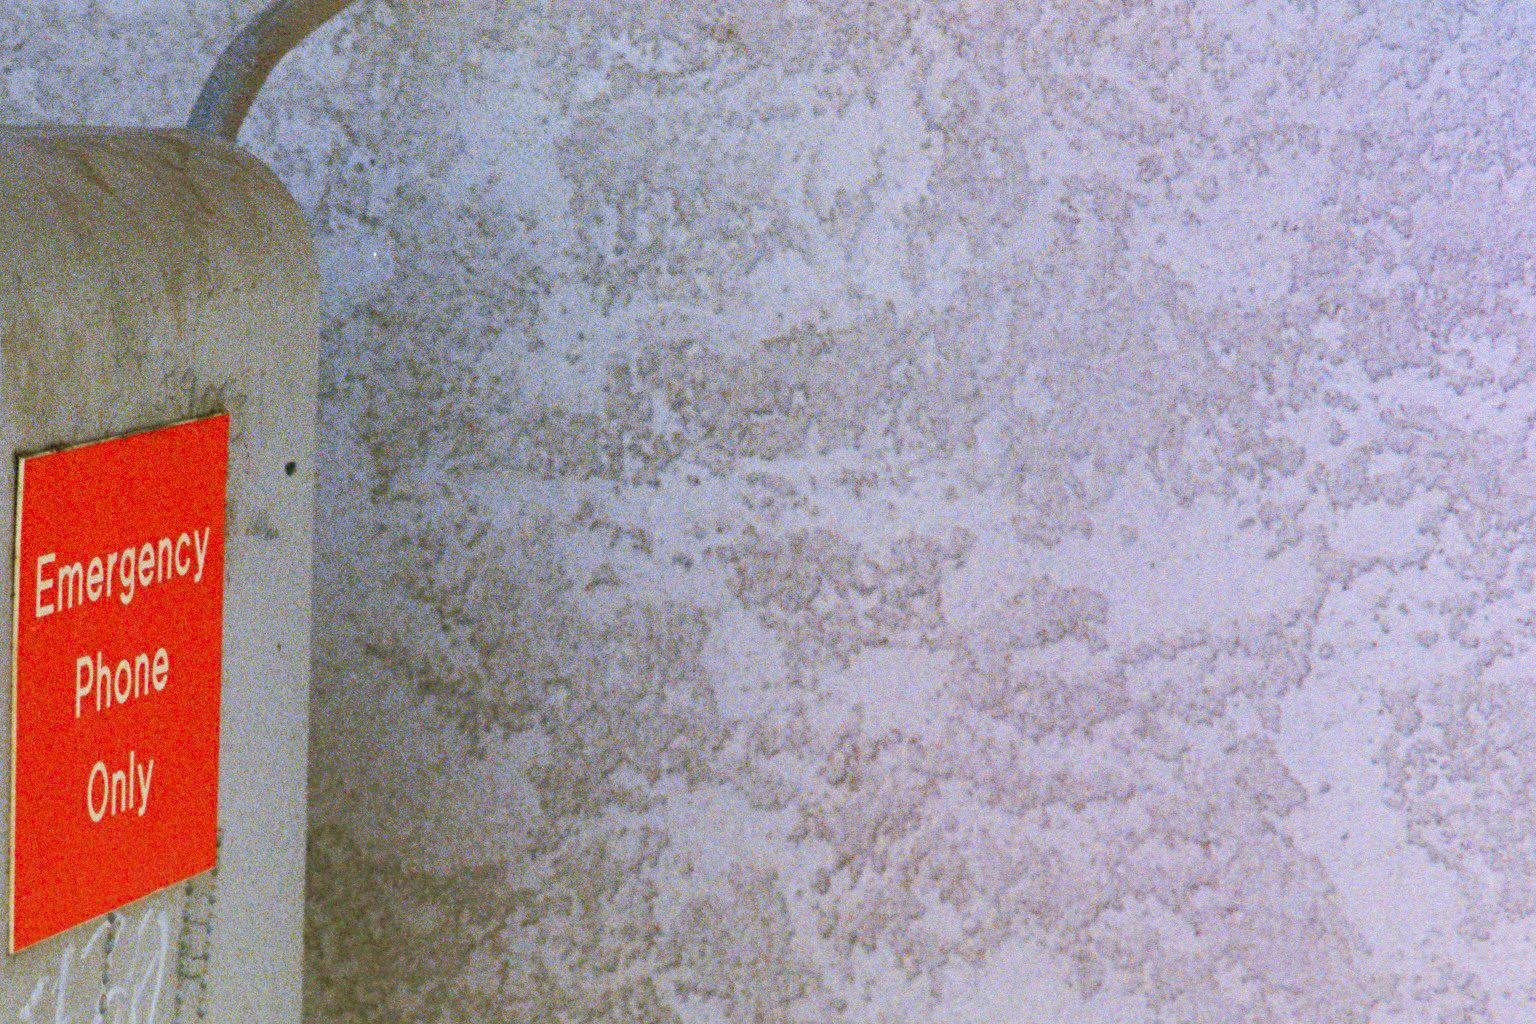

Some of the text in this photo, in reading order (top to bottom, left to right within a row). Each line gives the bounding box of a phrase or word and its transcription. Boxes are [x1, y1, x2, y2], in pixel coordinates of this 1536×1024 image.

[36, 526, 210, 617] Emergency
[75, 646, 169, 718] Phone
[88, 750, 154, 822] Only
